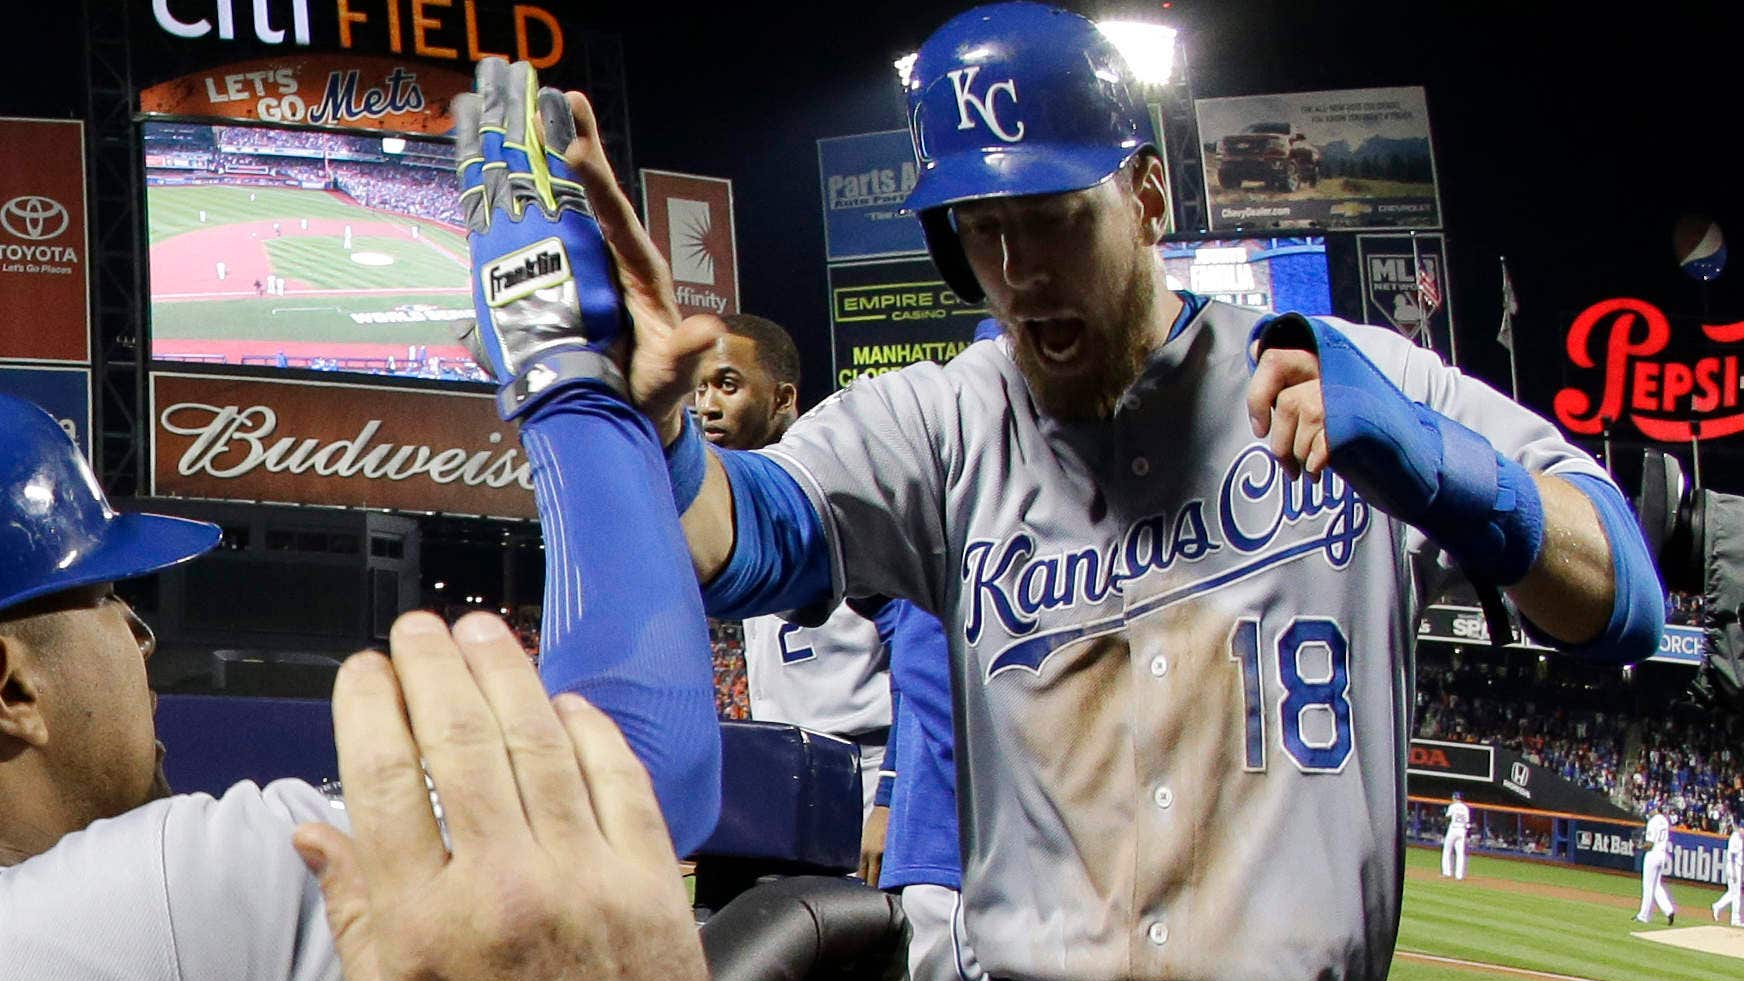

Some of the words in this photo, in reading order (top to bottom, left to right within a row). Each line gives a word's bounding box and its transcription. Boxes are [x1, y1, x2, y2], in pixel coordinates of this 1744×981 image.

[337, 0, 563, 70] FIELD
[205, 68, 298, 104] LET'S
[257, 95, 306, 122] GO
[308, 67, 424, 125] Mets
[946, 65, 1024, 143] KC
[828, 169, 897, 202] Parts
[26, 264, 39, 273] Go
[40, 264, 72, 275] Places
[674, 286, 727, 314] ffinity
[844, 292, 933, 312] EMPIRE
[891, 309, 946, 321] CASINO
[160, 402, 535, 490] Budweis
[1659, 634, 1704, 655] ORCH
[1228, 615, 1353, 775] 18
[1592, 832, 1609, 852] At
[1610, 836, 1634, 857] Bat
[1662, 841, 1727, 885] StubH
